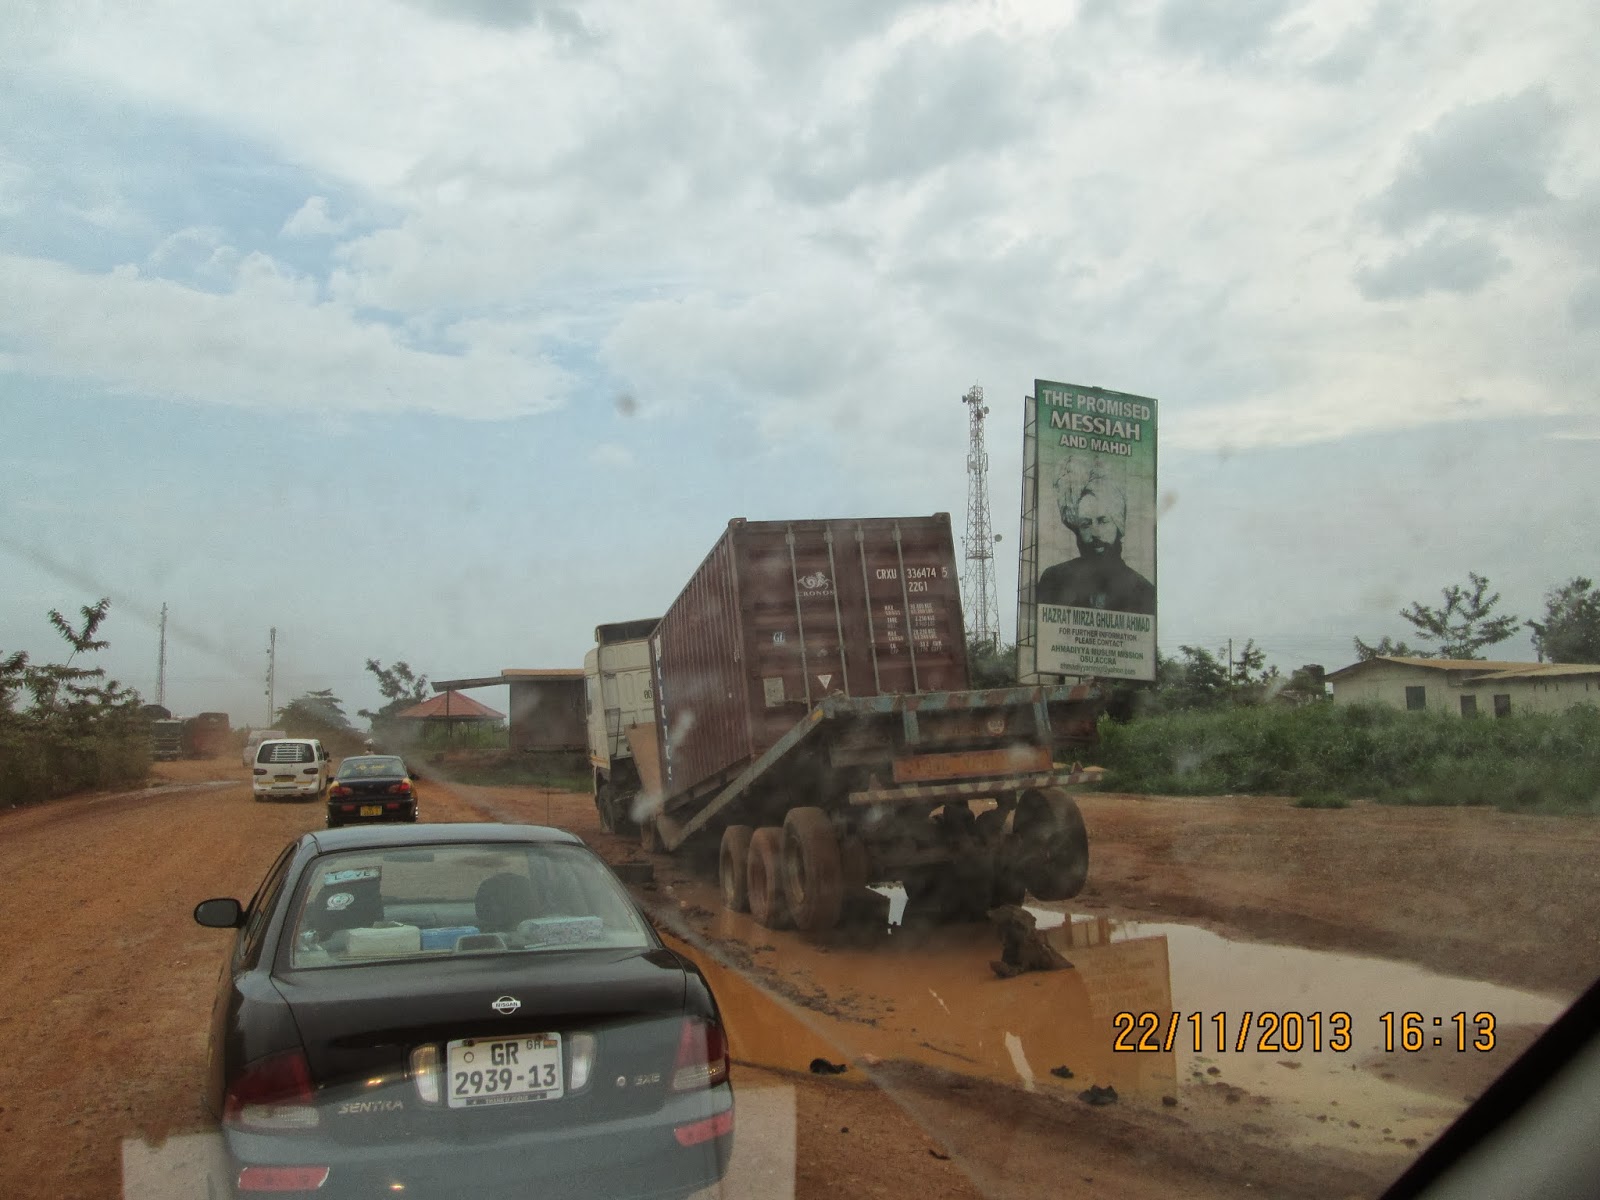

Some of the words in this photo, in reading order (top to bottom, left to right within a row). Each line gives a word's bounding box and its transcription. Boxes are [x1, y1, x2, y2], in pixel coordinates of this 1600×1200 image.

[1042, 389, 1073, 408] THE
[1077, 394, 1151, 421] PROMISED
[1051, 410, 1141, 441] MESSIAH
[1060, 434, 1088, 449] AND
[1091, 438, 1132, 456] MAHDI
[876, 568, 897, 579] CRXU
[907, 567, 937, 579] 336474
[908, 581, 928, 592] 22G1
[1042, 607, 1071, 625] HAZRAT
[1072, 610, 1094, 627] MIRZA
[1096, 612, 1125, 629] GHULAM
[1126, 615, 1150, 632] AHMAD
[1059, 627, 1071, 635] FOR
[1072, 628, 1098, 638] FURTHER
[1098, 630, 1137, 641] INFORMATION
[1074, 637, 1096, 645] PLEASE
[1097, 638, 1123, 648] CONTACT
[1051, 644, 1090, 655] AHMADIYYA
[1091, 648, 1117, 657] MUSLIM
[1117, 650, 1144, 660] MISSION
[491, 1042, 519, 1066] GR
[455, 1063, 556, 1096] 2939-13
[337, 1099, 404, 1115] SENTRA
